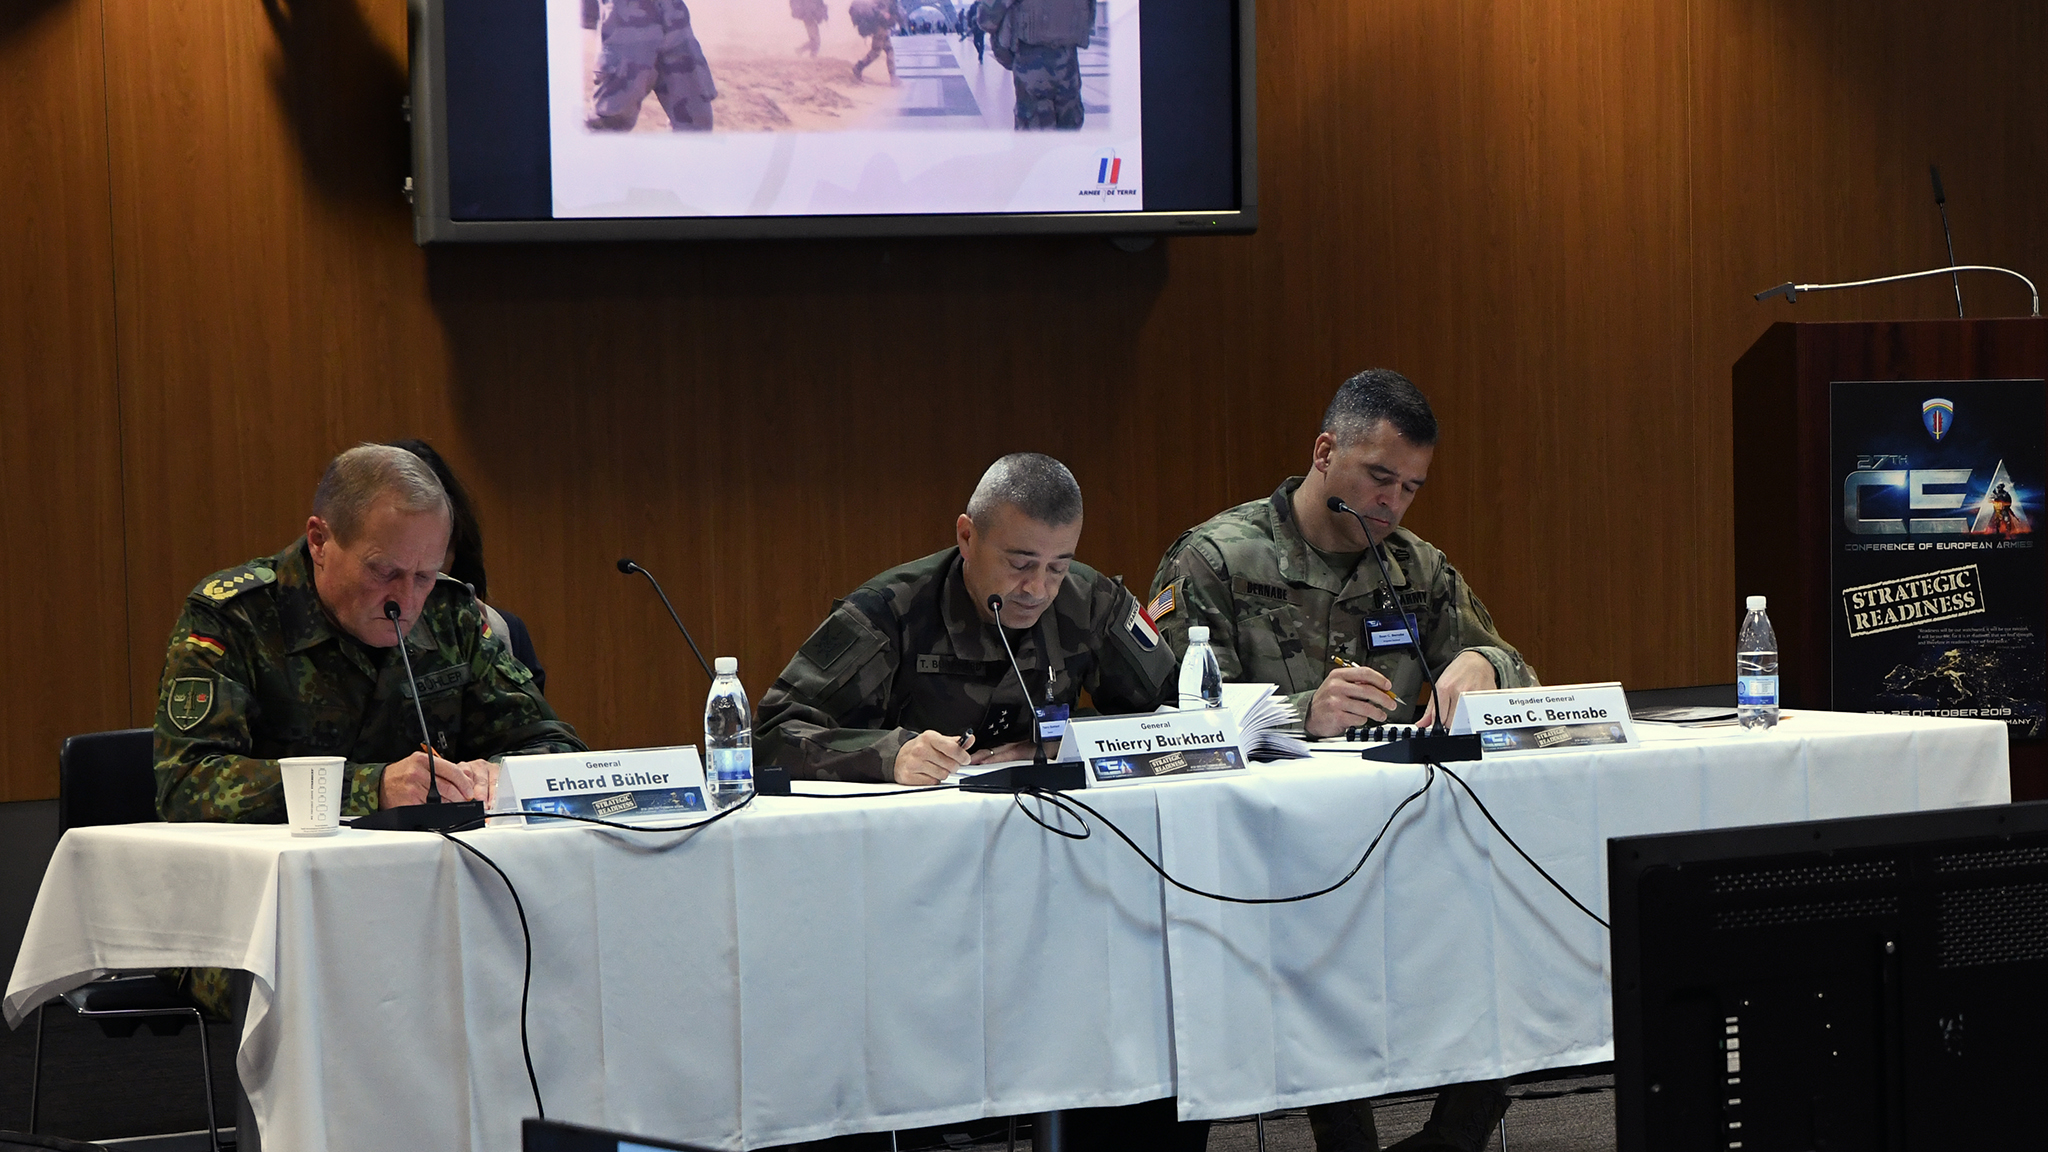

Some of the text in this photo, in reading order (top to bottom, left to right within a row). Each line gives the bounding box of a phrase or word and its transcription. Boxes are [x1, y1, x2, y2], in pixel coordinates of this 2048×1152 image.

[1844, 459, 2032, 535] CEA
[1844, 540, 2033, 551] CONFERENCE OF EUROPEAN ARMIES
[1247, 581, 1288, 600] BERNABE
[1852, 571, 1972, 610] STRATEGIC
[1853, 591, 1976, 630] READINESS
[919, 659, 929, 669] T.
[1508, 695, 1575, 706] Brigadier General
[1483, 707, 1608, 726] Sean C. Bernabe
[1980, 708, 2012, 717] 2019
[1140, 721, 1172, 730] General
[1094, 731, 1226, 753] Thierry Burkhard
[585, 760, 621, 769] General
[546, 771, 670, 792] Erhard Bühler
[595, 794, 632, 810] STRATEGIC
[597, 801, 635, 815] READINESS
